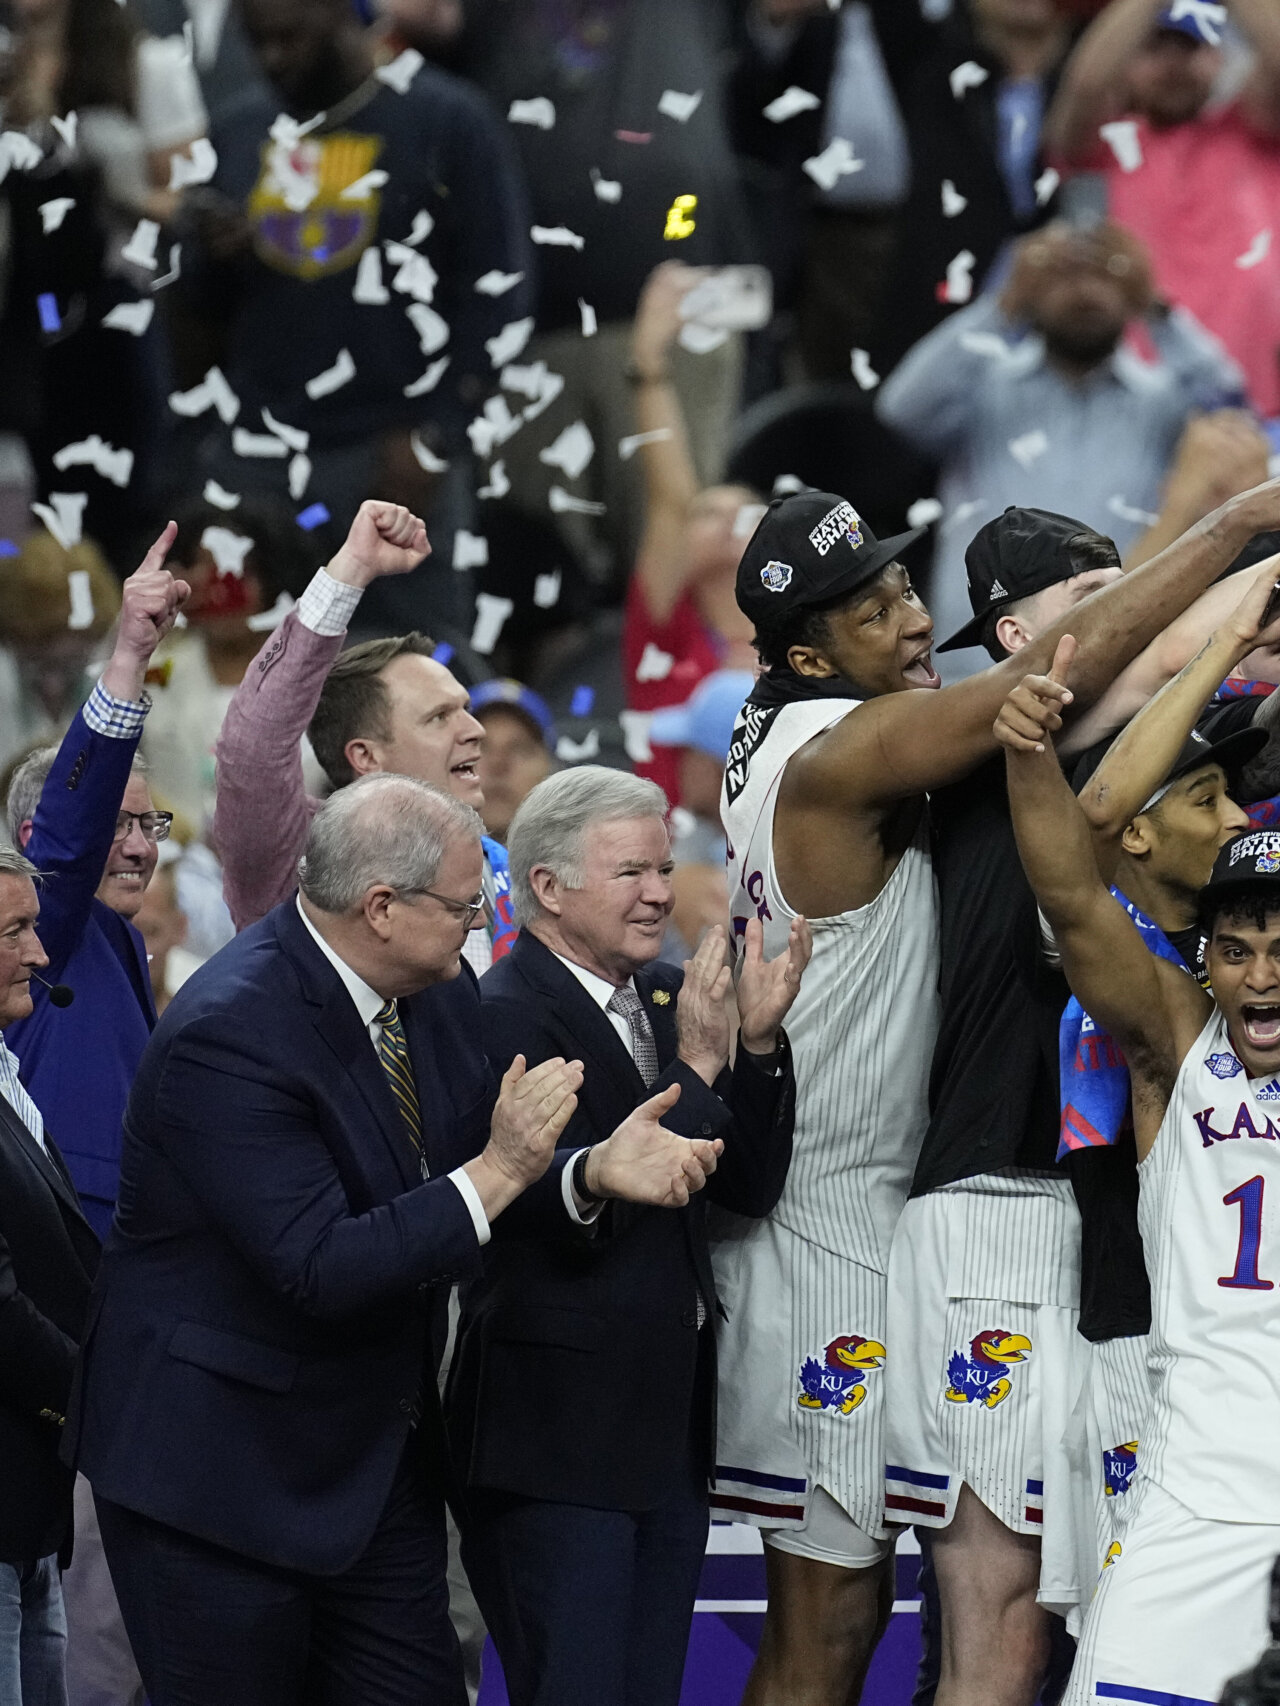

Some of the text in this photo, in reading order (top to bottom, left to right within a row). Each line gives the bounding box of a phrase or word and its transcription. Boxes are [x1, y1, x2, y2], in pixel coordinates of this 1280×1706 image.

[1216, 1058, 1234, 1066] FINAL
[820, 1375, 844, 1392] KU
[966, 1368, 989, 1386] KU
[1110, 1461, 1127, 1477] KU
